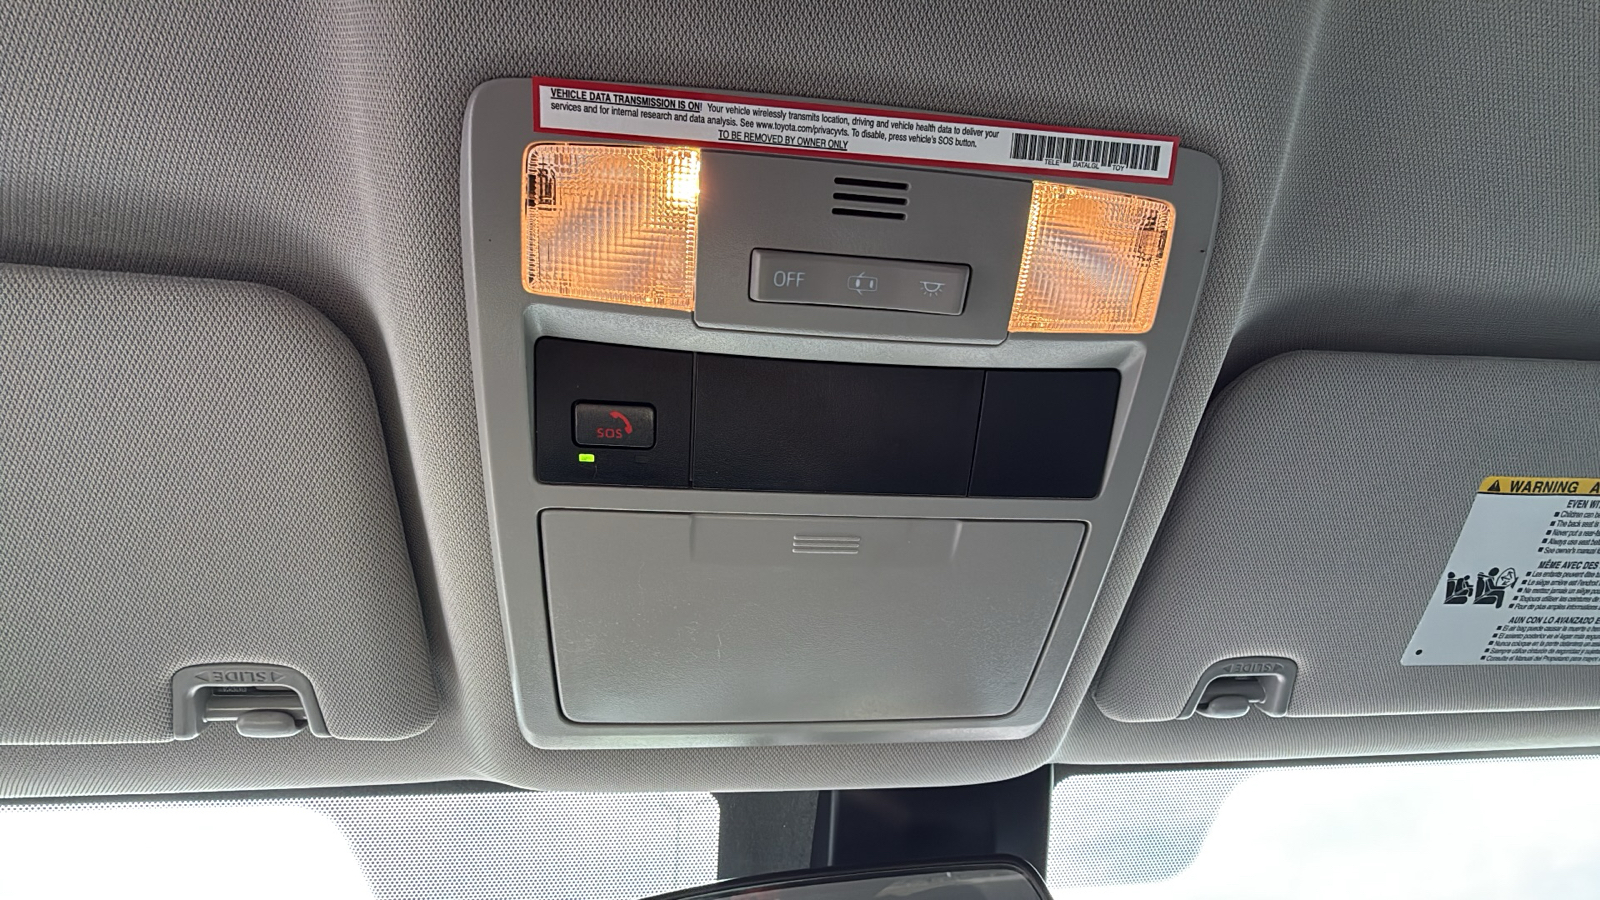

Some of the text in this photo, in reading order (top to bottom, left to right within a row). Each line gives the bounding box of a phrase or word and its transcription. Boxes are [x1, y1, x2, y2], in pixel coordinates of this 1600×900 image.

[550, 88, 999, 139] VEHICLE DATA TRANSMISSION IS ON! Your vehicle wirelessly transmits location, driving and vehicle health data to deliver your
[550, 102, 581, 112] services
[584, 104, 597, 113] and
[600, 105, 609, 114] for
[612, 106, 638, 118] internal
[641, 110, 672, 120] research
[674, 112, 688, 122] and
[690, 113, 705, 124] data
[707, 116, 738, 127] analysis.
[740, 118, 754, 128] See
[852, 128, 860, 137] To
[862, 130, 886, 141] disable,
[888, 134, 906, 142] press
[908, 132, 936, 144] vehicle's
[938, 136, 954, 146] SOS
[955, 138, 977, 148] button.
[718, 130, 848, 149] TO BE REMOVED BY OWNER ONLY
[1044, 158, 1060, 166] TELE
[773, 270, 805, 288] OFF
[596, 428, 622, 438] SOS
[1510, 481, 1579, 493] WARNING
[1567, 500, 1600, 508] EVEN WIT
[1561, 561, 1583, 569] AVEC
[1583, 561, 1599, 569] DES
[1508, 616, 1526, 624] AUN
[1526, 616, 1543, 624] CON
[1543, 616, 1554, 624] LO
[1554, 616, 1595, 624] AVANZADO
[212, 671, 266, 682] SLIDE
